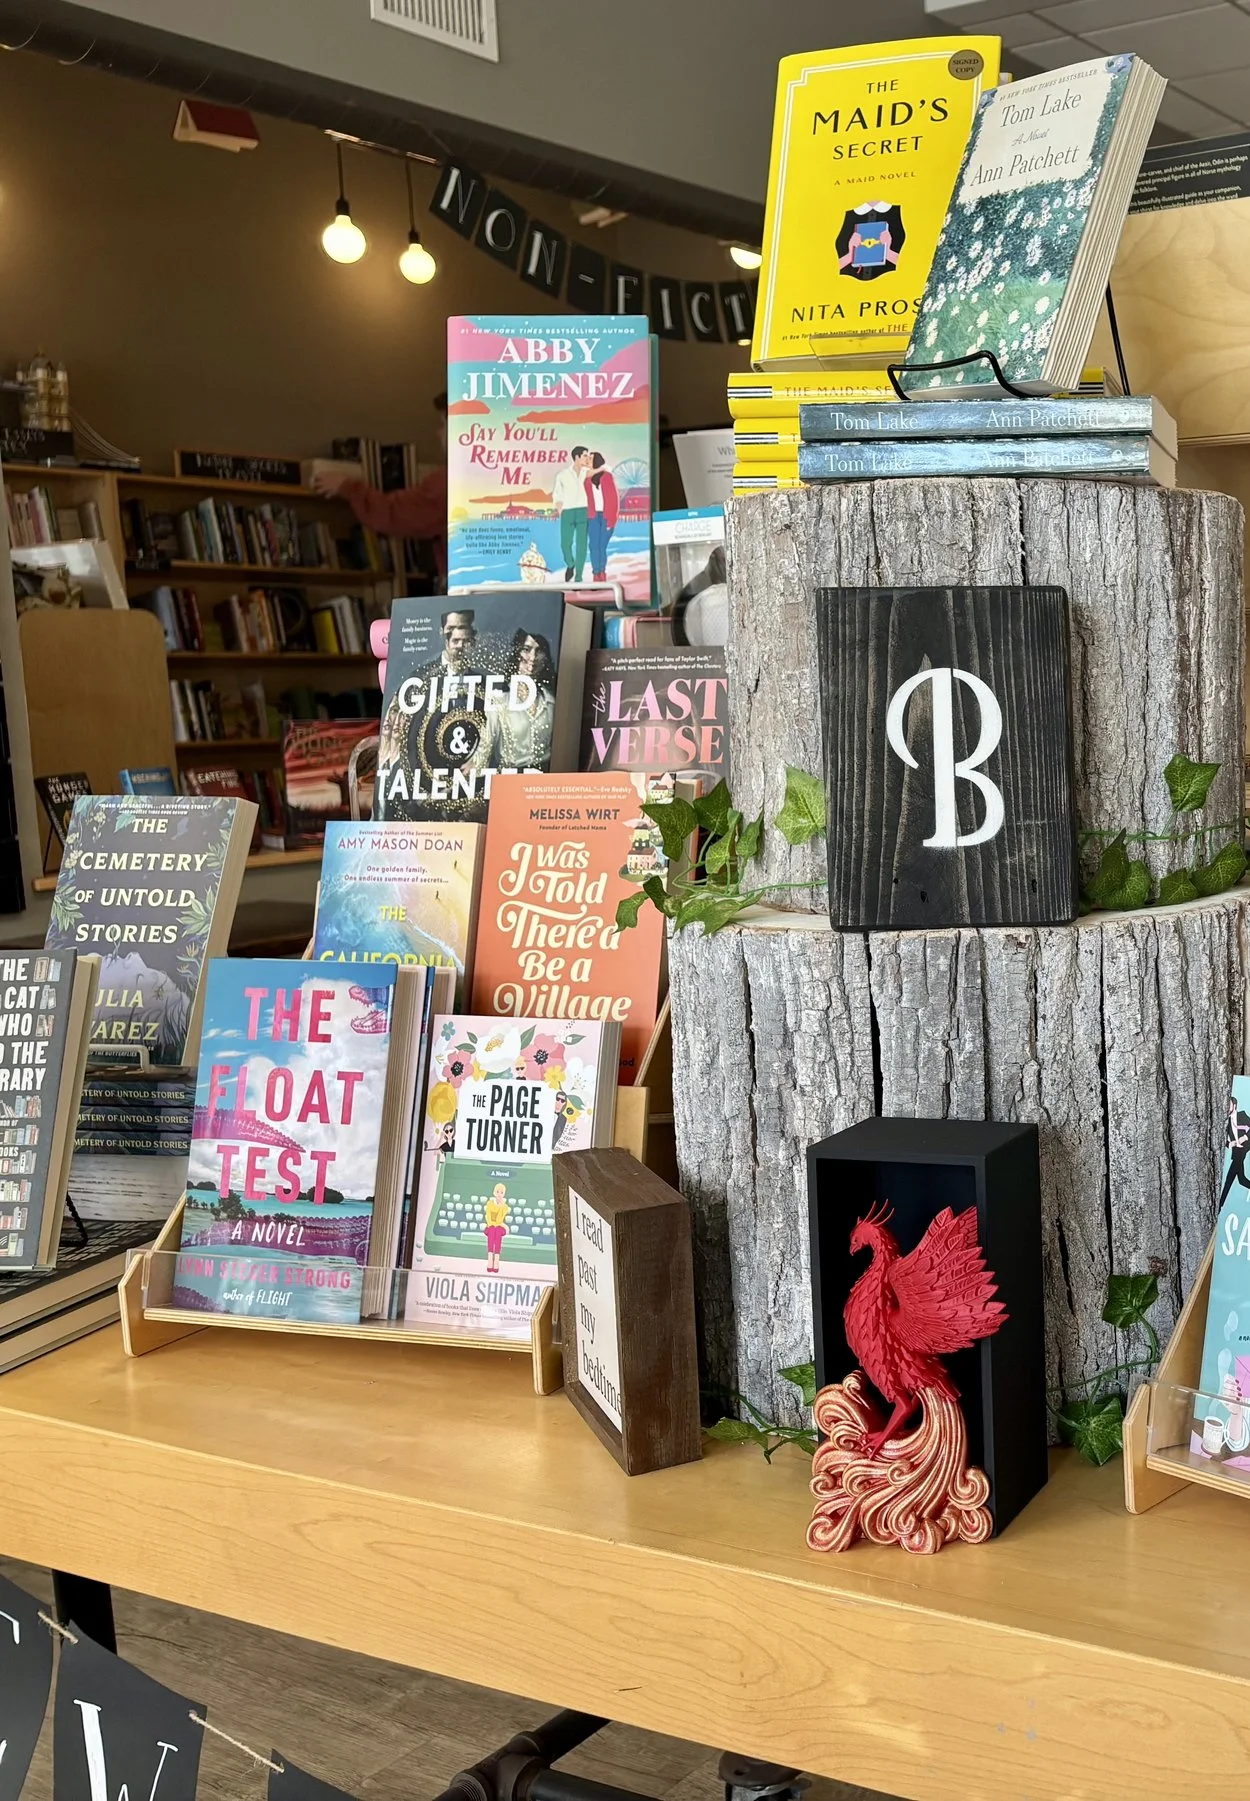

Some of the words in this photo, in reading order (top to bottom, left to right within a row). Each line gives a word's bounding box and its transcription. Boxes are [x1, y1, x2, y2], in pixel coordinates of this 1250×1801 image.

[866, 79, 899, 94] THE
[812, 97, 948, 135] MAID'S
[1000, 104, 1035, 128] Tom
[1039, 88, 1082, 117] Lake
[832, 136, 924, 160] SECRET
[847, 175, 875, 184] MAID
[879, 171, 917, 181] NOVEL
[970, 164, 1003, 187] Ann
[1009, 145, 1080, 177] Patchett
[440, 166, 747, 334] NON-FICT
[792, 304, 845, 323] NITA
[859, 299, 922, 317] PROS
[497, 337, 601, 364] ABBY
[462, 371, 636, 401] JIMENEZ
[830, 412, 870, 431] Tom
[877, 411, 919, 430] Lake
[986, 409, 1023, 428] Ann
[1030, 408, 1101, 427] Patchett
[470, 444, 568, 470] REMEMBER
[824, 454, 864, 472] Tom
[872, 453, 913, 471] Lake
[981, 450, 1016, 468] Ann
[1023, 450, 1095, 468] Patchett
[398, 674, 538, 715] GIFTED
[608, 678, 728, 723] LAST
[449, 726, 470, 754] &
[591, 725, 724, 766] VERSE
[886, 667, 1005, 848] B
[132, 818, 169, 834] THE
[529, 808, 581, 820] MELISSA
[586, 808, 620, 820] WIRT
[337, 838, 368, 850] AMY
[371, 838, 419, 851] MASON
[424, 839, 464, 851] DOAN
[536, 841, 591, 869] Was
[79, 852, 208, 872] CEMETERY
[382, 865, 405, 875] golden
[75, 890, 95, 903] OF
[100, 888, 196, 908] UNTOLD
[529, 869, 608, 905] Told
[380, 905, 408, 922] THE
[75, 924, 178, 943] STORIES
[518, 949, 562, 982] Be
[570, 957, 593, 983] a
[4, 986, 40, 1009] CAT
[493, 982, 632, 1022] Village
[244, 987, 336, 1043] THE
[11, 1041, 49, 1065] THE
[117, 1090, 149, 1098] UNTOLD
[151, 1091, 185, 1099] STORIES
[208, 1063, 364, 1125] FLOAT
[472, 1094, 487, 1109] THE
[490, 1084, 542, 1119] PAGE
[120, 1115, 151, 1123] UNTOLD
[154, 1115, 188, 1124] STORIES
[466, 1117, 544, 1155] TURNER
[216, 1144, 336, 1206] TEST
[251, 1221, 306, 1247] NOVEL
[581, 1210, 604, 1255] read
[178, 1256, 214, 1278] LYNN
[219, 1258, 279, 1285] STEGER
[284, 1264, 351, 1290] STRONG
[577, 1253, 598, 1295] past
[426, 1276, 471, 1302] VIOLA
[475, 1281, 541, 1308] SHIPMA
[580, 1300, 597, 1345] my
[582, 1340, 622, 1416] bedtime
